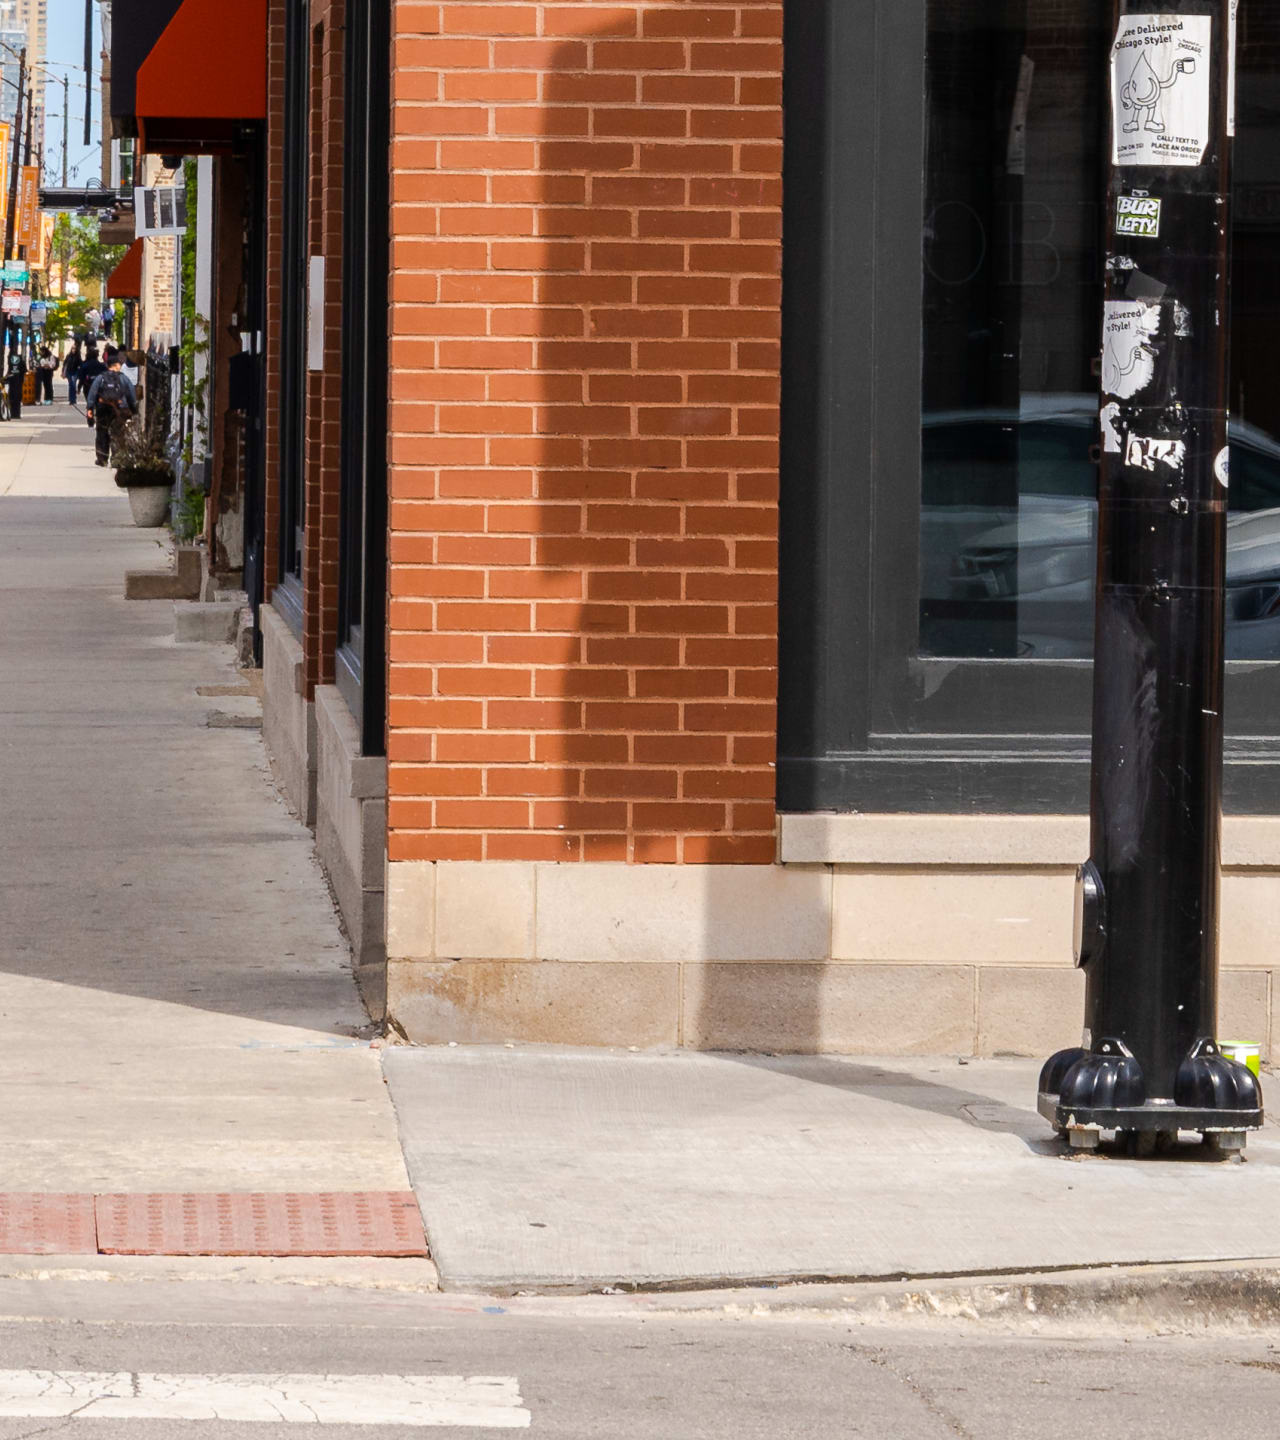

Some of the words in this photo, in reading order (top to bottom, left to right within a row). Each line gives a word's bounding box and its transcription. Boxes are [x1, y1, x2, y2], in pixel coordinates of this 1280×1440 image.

[1137, 21, 1184, 35] Delivered
[1144, 34, 1172, 46] Style!
[1177, 42, 1202, 54] CHICAGO
[1151, 142, 1170, 150] PLACE
[1175, 136, 1190, 144] TEXT
[1190, 138, 1199, 146] TO
[1117, 215, 1157, 233] LEFTY
[1111, 321, 1131, 332] Style!
